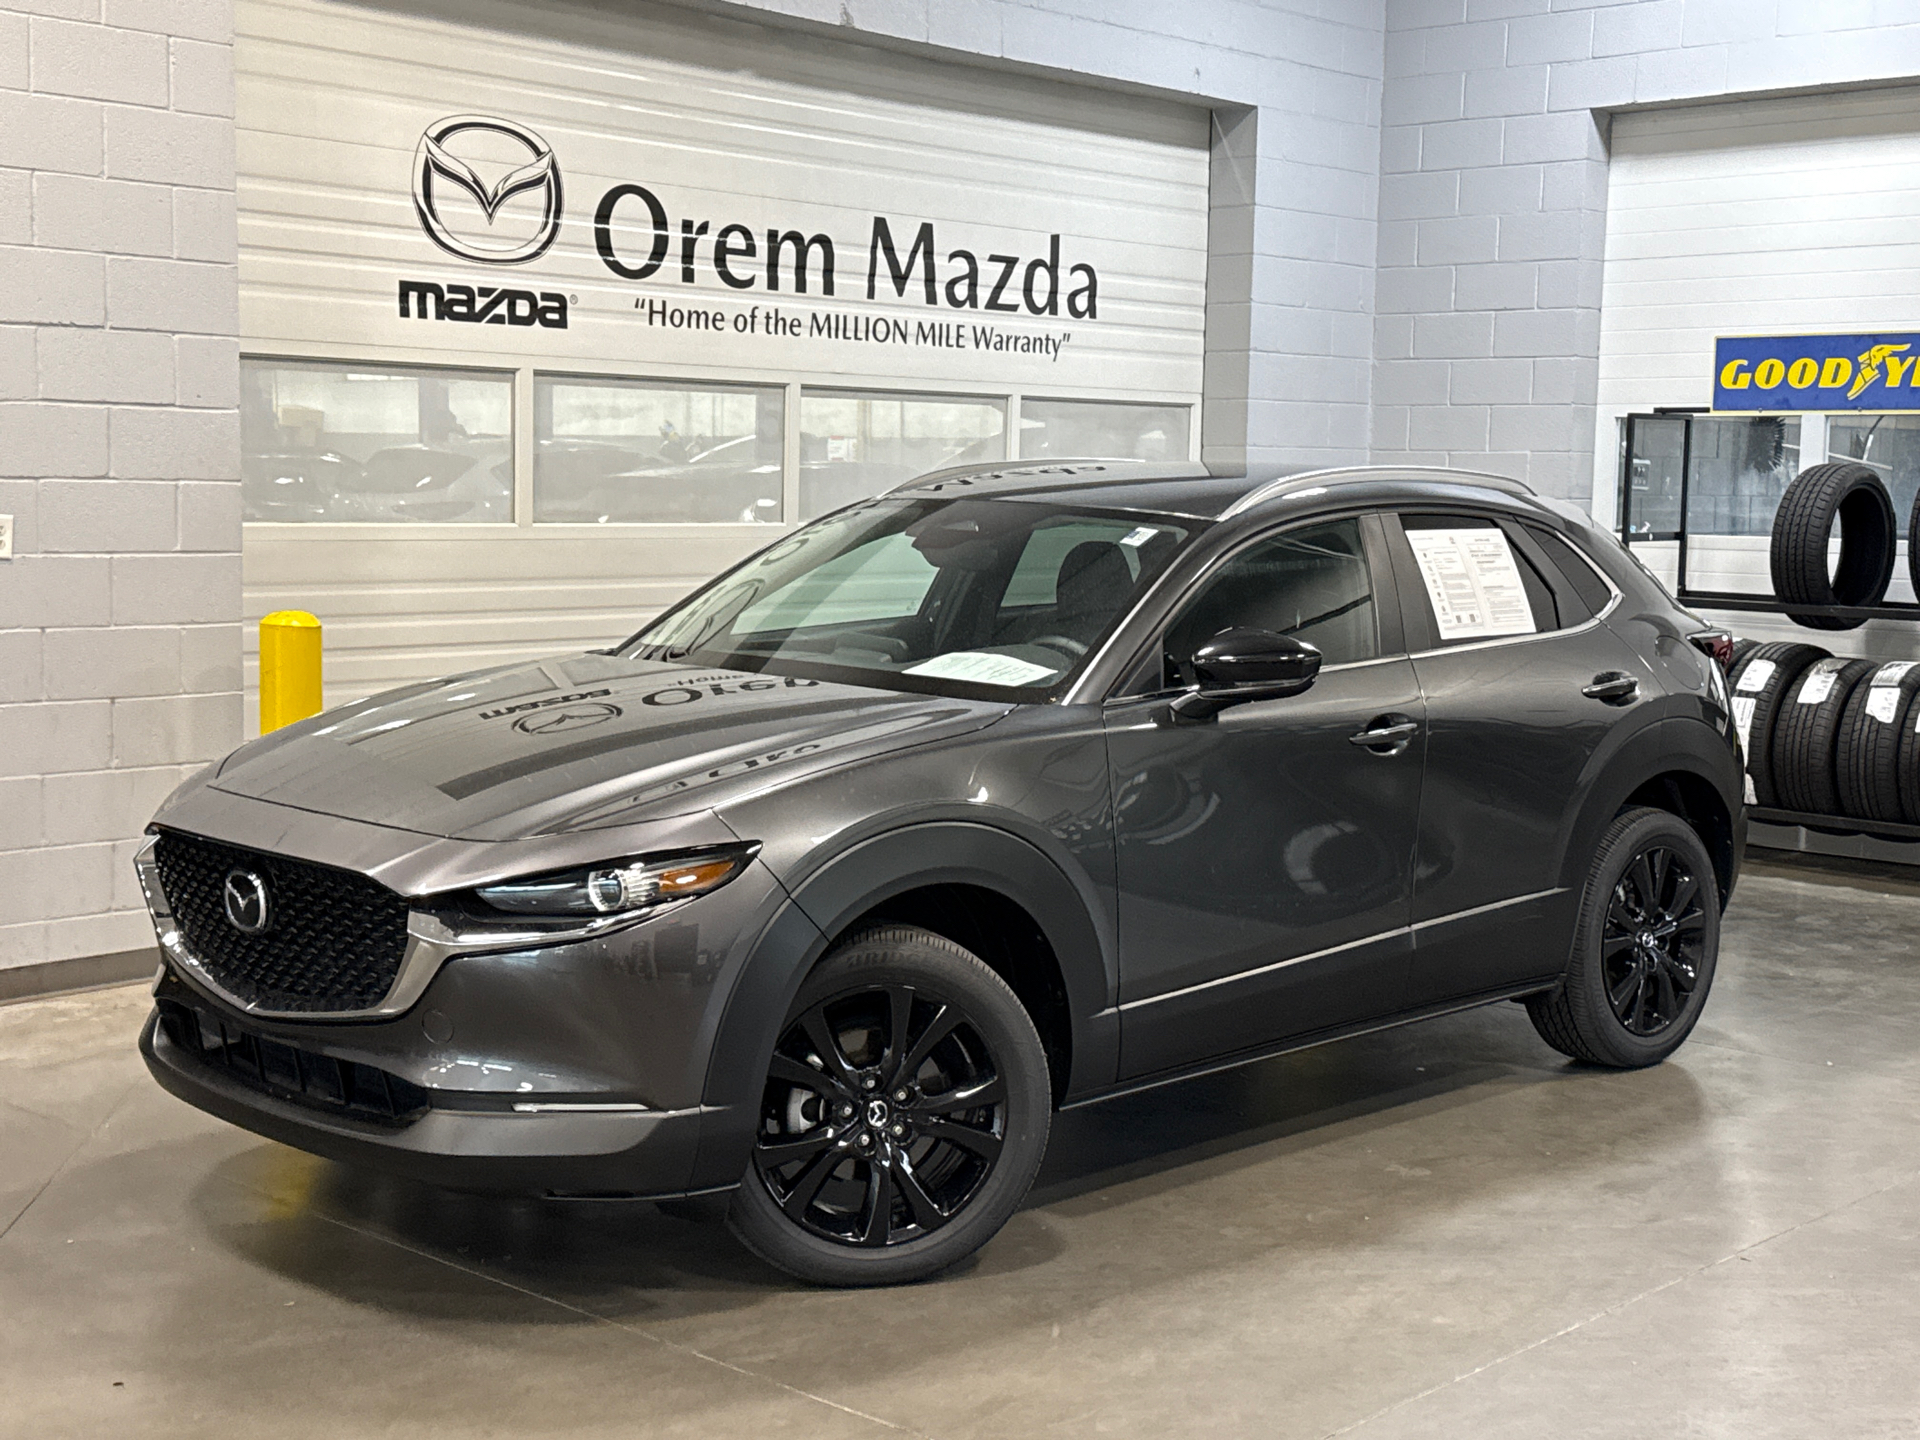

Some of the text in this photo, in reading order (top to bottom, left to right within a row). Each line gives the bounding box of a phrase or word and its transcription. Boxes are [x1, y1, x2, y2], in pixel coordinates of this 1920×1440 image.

[594, 184, 1098, 319] Orem Mazda
[399, 280, 568, 329] mazda
[634, 298, 1071, 362] "Home of the MILLION MILE Warranty"
